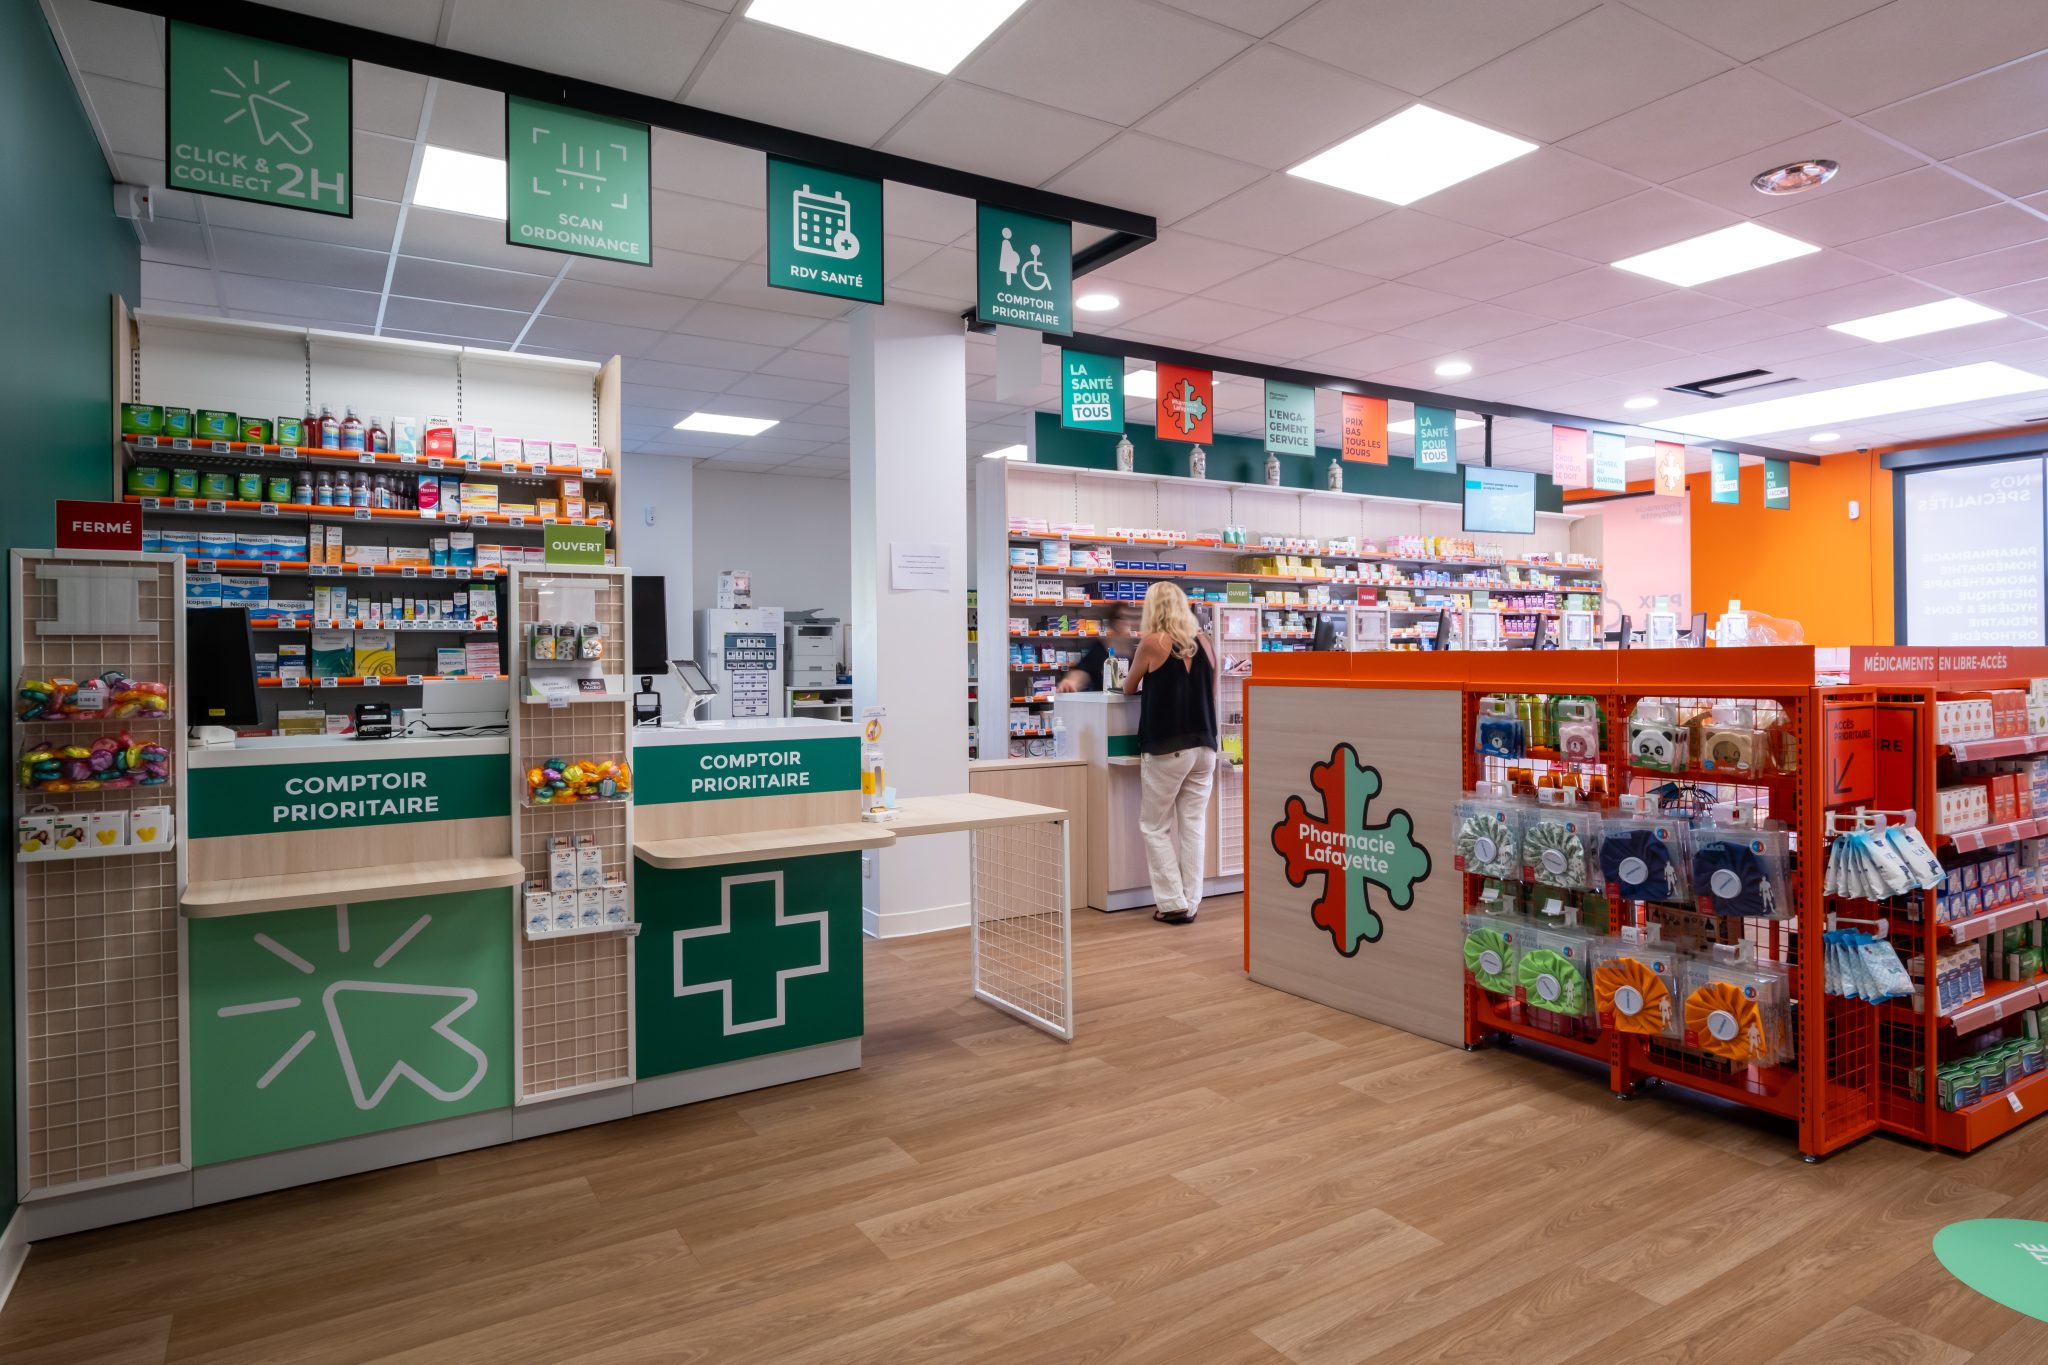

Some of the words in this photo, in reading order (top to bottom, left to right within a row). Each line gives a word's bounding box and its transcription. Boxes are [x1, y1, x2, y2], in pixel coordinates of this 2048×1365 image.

[175, 144, 248, 170] CLICK
[255, 157, 269, 173] &
[174, 164, 271, 192] COLLECT
[276, 163, 344, 205] 2H
[559, 213, 603, 232] SCAN
[520, 224, 639, 254] ORDONNANCE
[790, 264, 818, 279] RDV
[821, 270, 863, 288] SANTÉ
[997, 292, 1054, 311] COMPTOIR
[992, 305, 1059, 326] PRIORITAIRE
[1070, 364, 1087, 375] LA
[1071, 376, 1113, 390] SANTÉ
[1073, 393, 1109, 404] POUR
[1074, 407, 1109, 418] TOUS
[1269, 409, 1306, 422] L'ENGA-
[1269, 422, 1308, 434] GEMENT
[1345, 417, 1363, 426] PRIX
[1420, 417, 1431, 427] LA
[1346, 427, 1360, 436] BAS
[1421, 426, 1448, 438] SANTÉ
[1269, 434, 1308, 446] SERVICE
[1345, 437, 1366, 447] TOUS
[1367, 440, 1381, 449] LES
[1422, 440, 1446, 449] POUR
[1345, 447, 1370, 457] JOURS
[1423, 451, 1446, 461] TOUS
[1766, 471, 1774, 479] ICI
[1767, 480, 1776, 488] ON
[72, 520, 132, 534] FERMÉ
[552, 541, 601, 552] OUVERT
[1863, 652, 1934, 672] MÉDICAMENTS
[1939, 656, 1951, 671] EN
[1953, 651, 2007, 671] LIBRE-ACCÈS
[1834, 718, 1854, 730] ACCÈS
[1833, 729, 1871, 742] PRIORITAIRE
[700, 751, 801, 770] COMPTOIR
[285, 771, 427, 795] COMPTOIR
[691, 771, 810, 793] PRIORITAIRE
[273, 796, 439, 822] PRIORITAIRE
[1299, 824, 1395, 855] Pharmacie
[1305, 843, 1389, 874] Lafayette
